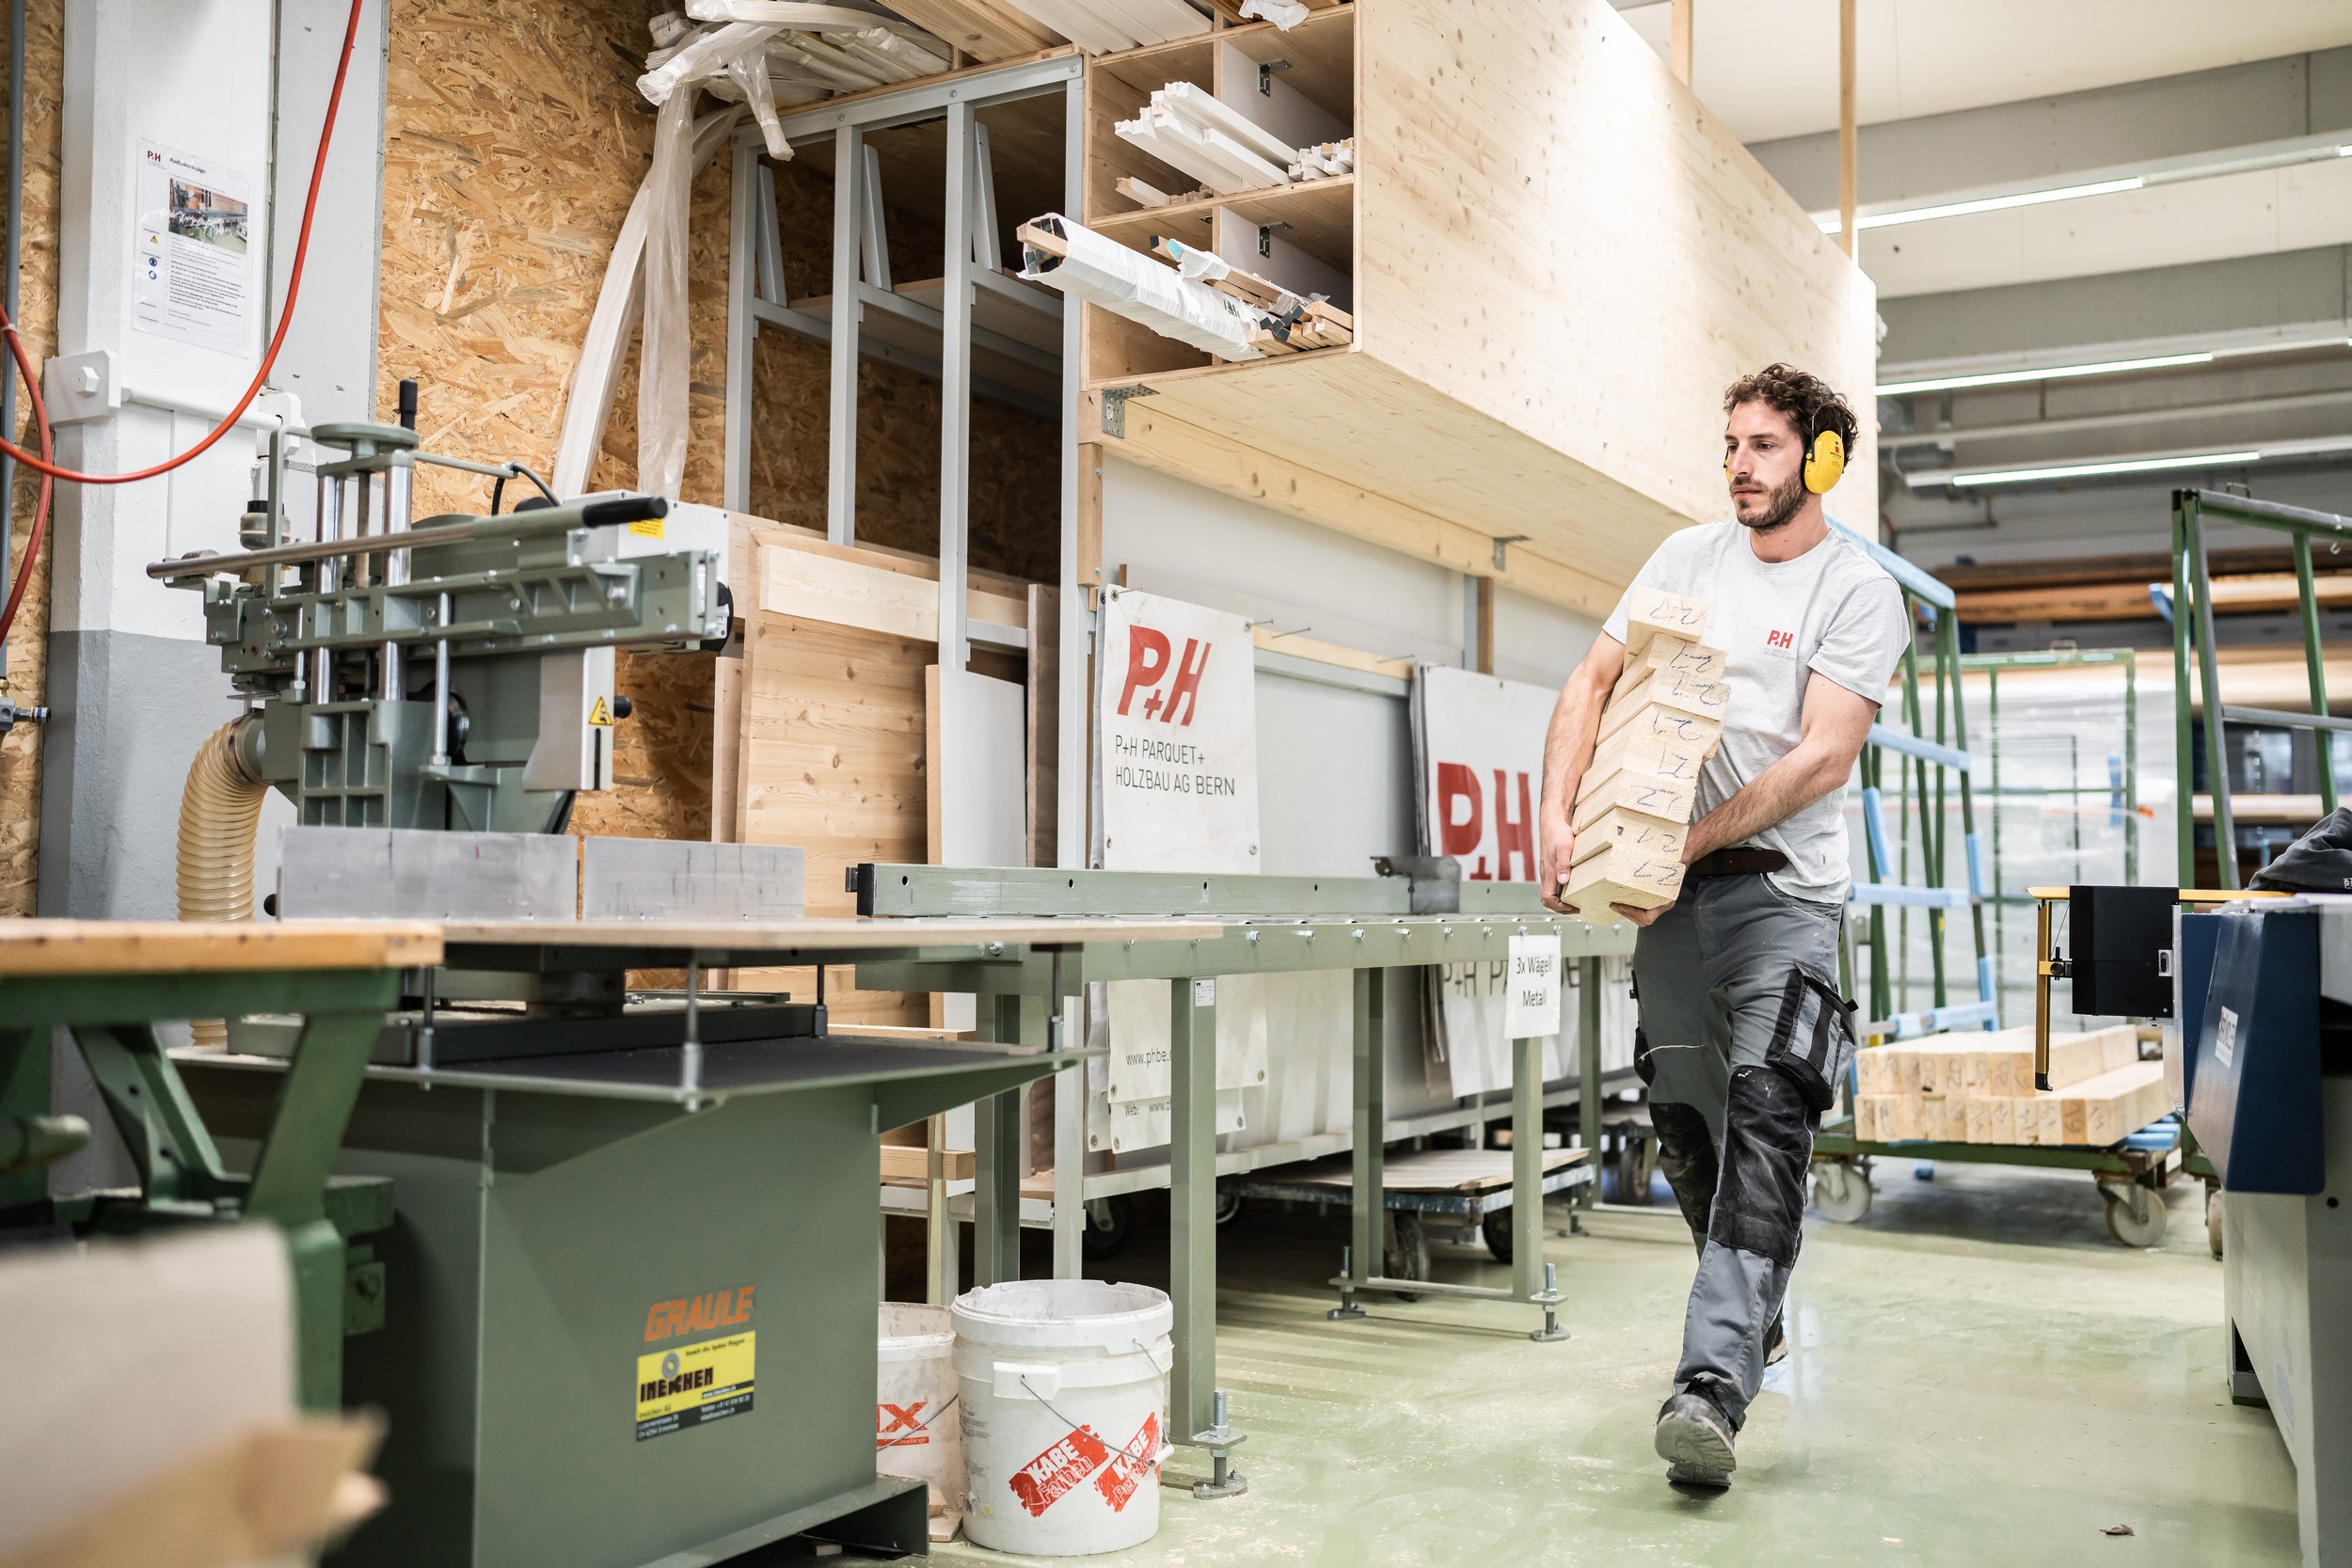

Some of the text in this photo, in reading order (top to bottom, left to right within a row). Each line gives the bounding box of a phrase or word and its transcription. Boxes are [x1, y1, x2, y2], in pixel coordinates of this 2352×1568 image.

[1767, 629, 1794, 649] P+H
[1117, 624, 1212, 727] P+H
[1115, 735, 1205, 765] P+H PARQUET+
[1116, 765, 1235, 797] HOLZBAU AG BERN
[1517, 958, 1526, 974] 3x
[1528, 955, 1553, 977] Wägeli
[1522, 988, 1548, 1008] Metall
[644, 1285, 755, 1342] GRAULE
[1026, 1437, 1080, 1486] KABE
[1111, 1428, 1150, 1481] KABE
[1036, 1455, 1095, 1505] Farben
